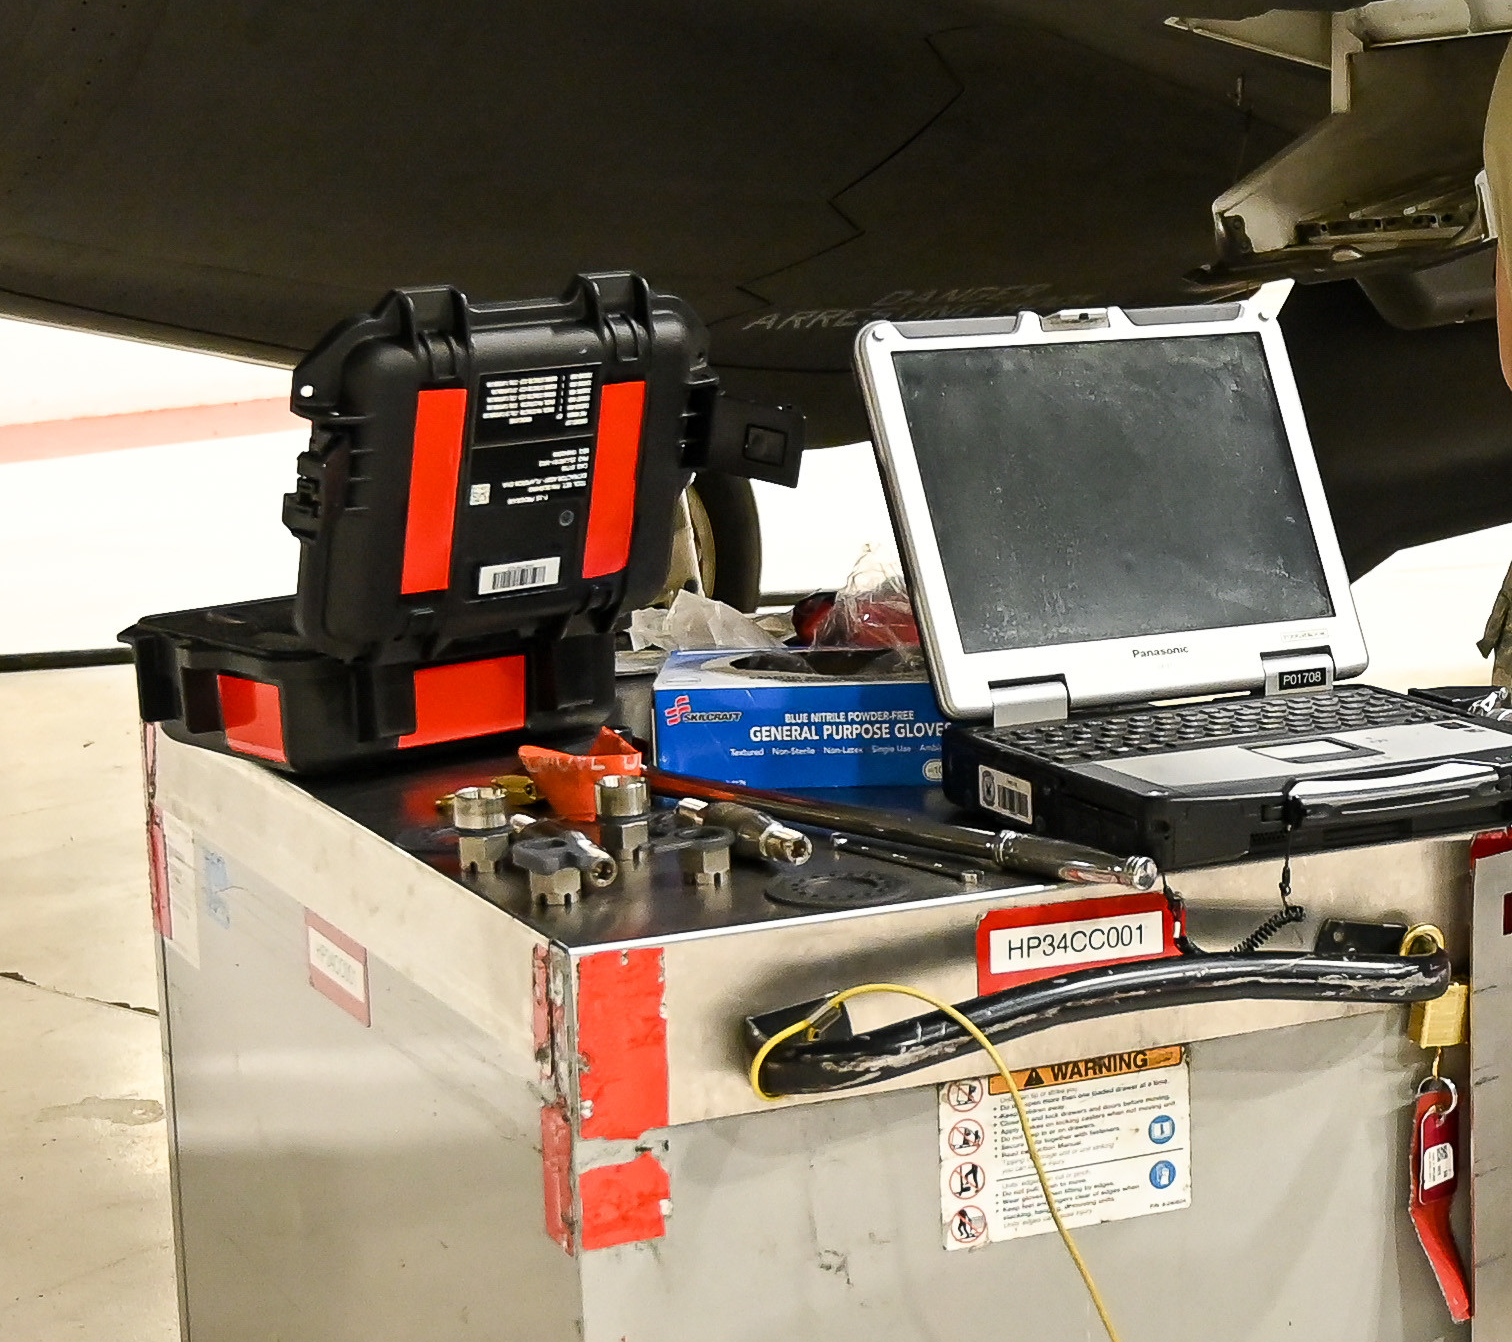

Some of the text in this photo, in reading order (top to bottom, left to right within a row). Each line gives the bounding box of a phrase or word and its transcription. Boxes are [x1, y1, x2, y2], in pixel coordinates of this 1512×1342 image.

[1132, 645, 1189, 659] Panasonic
[1282, 671, 1322, 686] P01708
[683, 711, 742, 723] SKILCRAFT
[784, 710, 914, 724] BLUE NITRILE POWDER-FREE
[749, 725, 820, 742] GENERAL
[823, 723, 890, 740] PURPOSE
[1007, 923, 1144, 961] HP34CC001
[1050, 1050, 1149, 1081] WARNING
